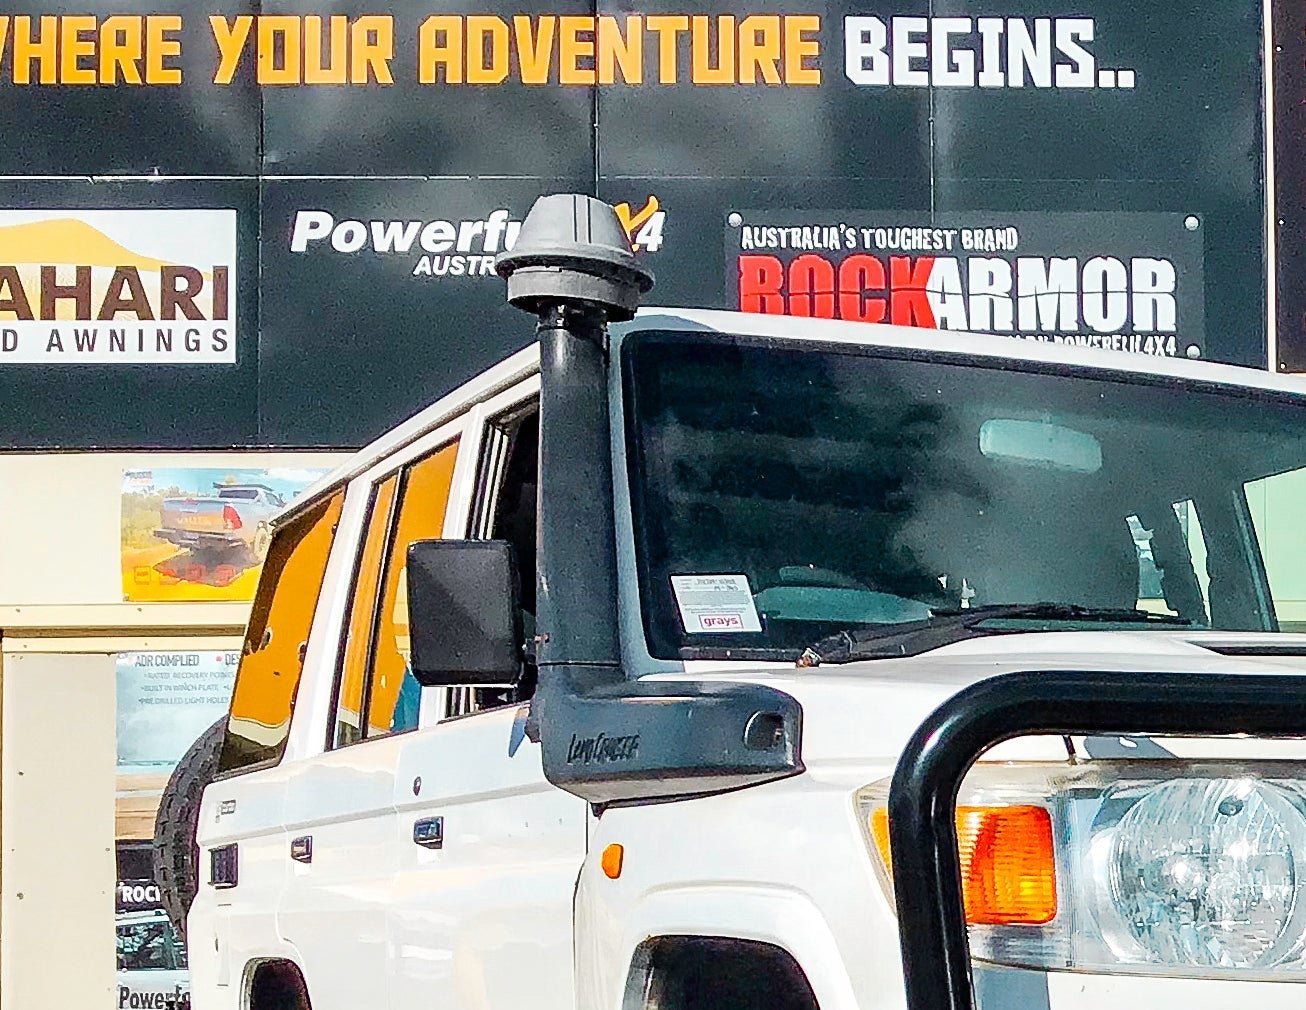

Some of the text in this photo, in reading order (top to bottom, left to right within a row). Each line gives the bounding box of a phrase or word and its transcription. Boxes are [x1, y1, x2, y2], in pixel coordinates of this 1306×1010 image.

[0, 15, 1135, 88] HERE YOUR ADVENTURE BEGINS..
[741, 223, 1018, 251] AUSTRALIA'S TOUGHEST BRAND
[739, 254, 1177, 332] ROCKARMOR
[46, 328, 229, 352] AWNINGS
[703, 617, 739, 627] grays
[135, 654, 154, 666] ADR
[155, 654, 200, 666] COMPLIED
